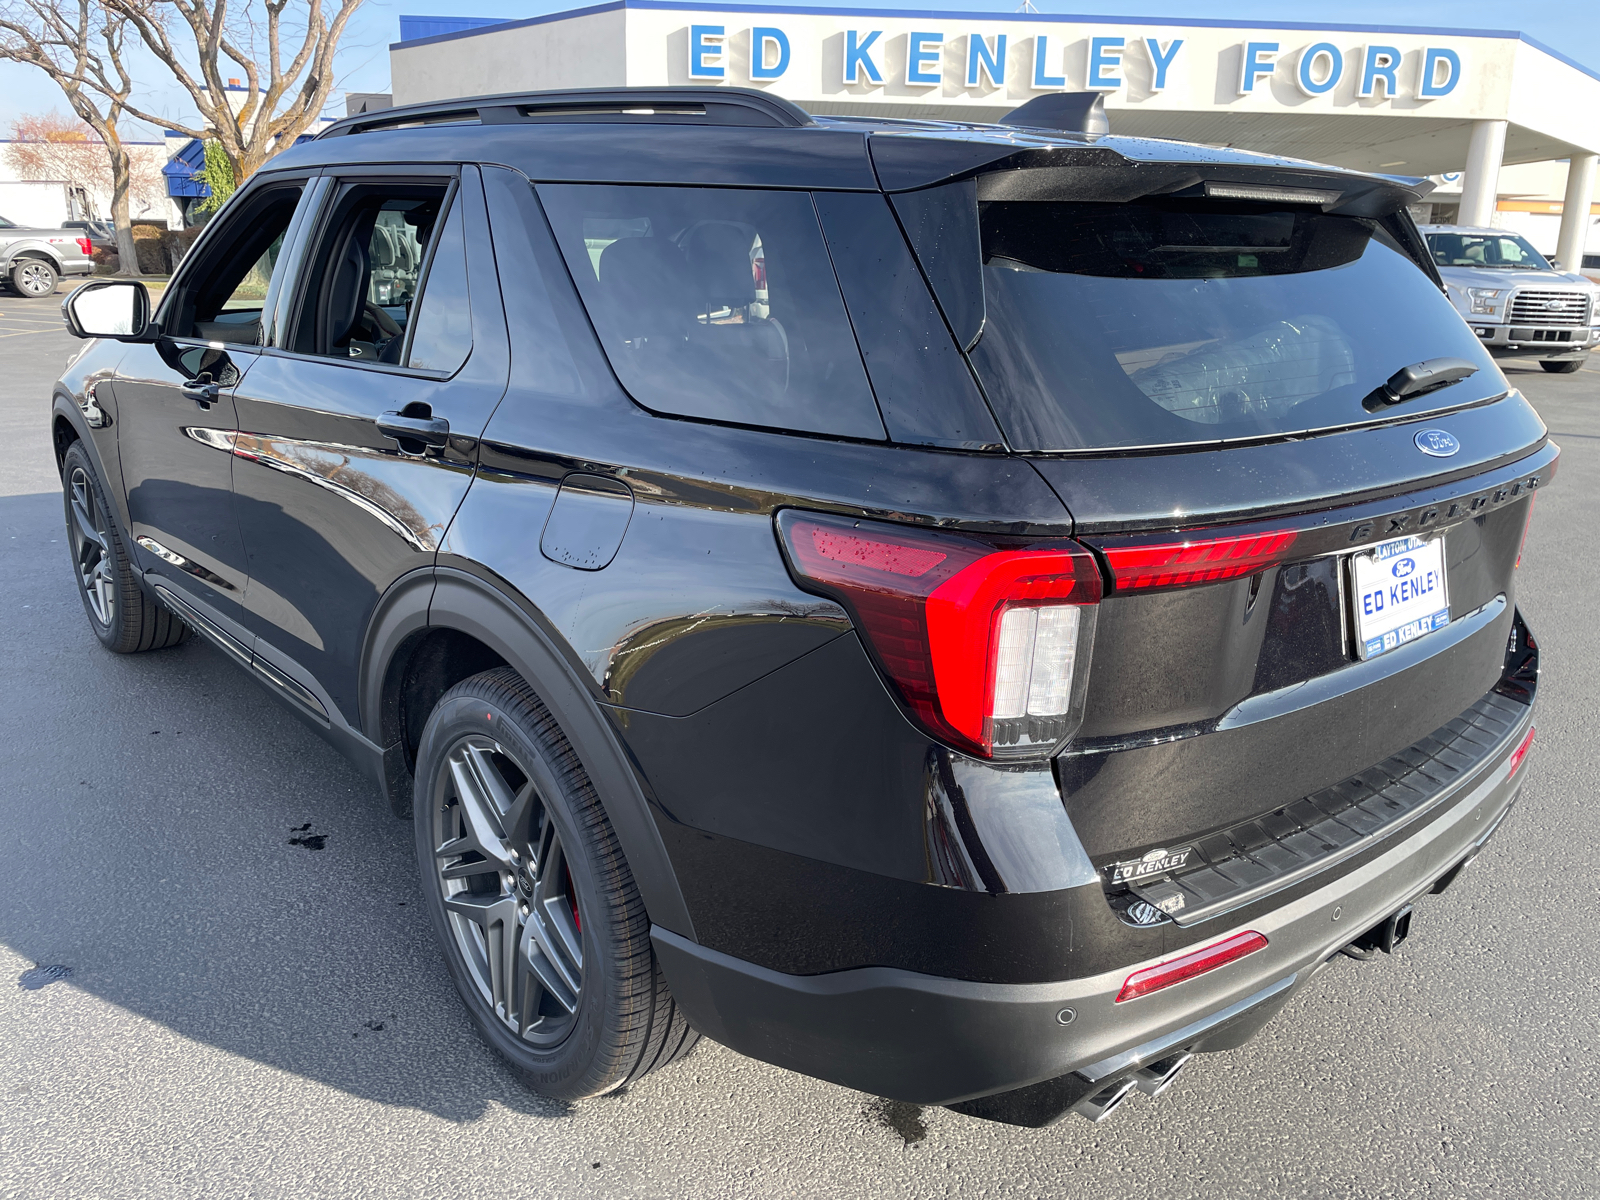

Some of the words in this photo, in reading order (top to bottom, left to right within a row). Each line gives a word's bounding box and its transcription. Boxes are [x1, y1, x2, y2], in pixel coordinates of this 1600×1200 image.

[689, 25, 790, 79] ED
[844, 30, 1184, 91] KENLEY
[1242, 42, 1461, 97] FORD
[1427, 432, 1454, 449] Ford
[1350, 475, 1541, 541] EXPLORER
[1396, 560, 1412, 577] Ford
[1363, 590, 1384, 615] ED
[1390, 568, 1440, 607] KENLEY
[1383, 631, 1397, 650] ED
[1398, 615, 1433, 643] KENLEY
[1136, 852, 1189, 875] KENLEY
